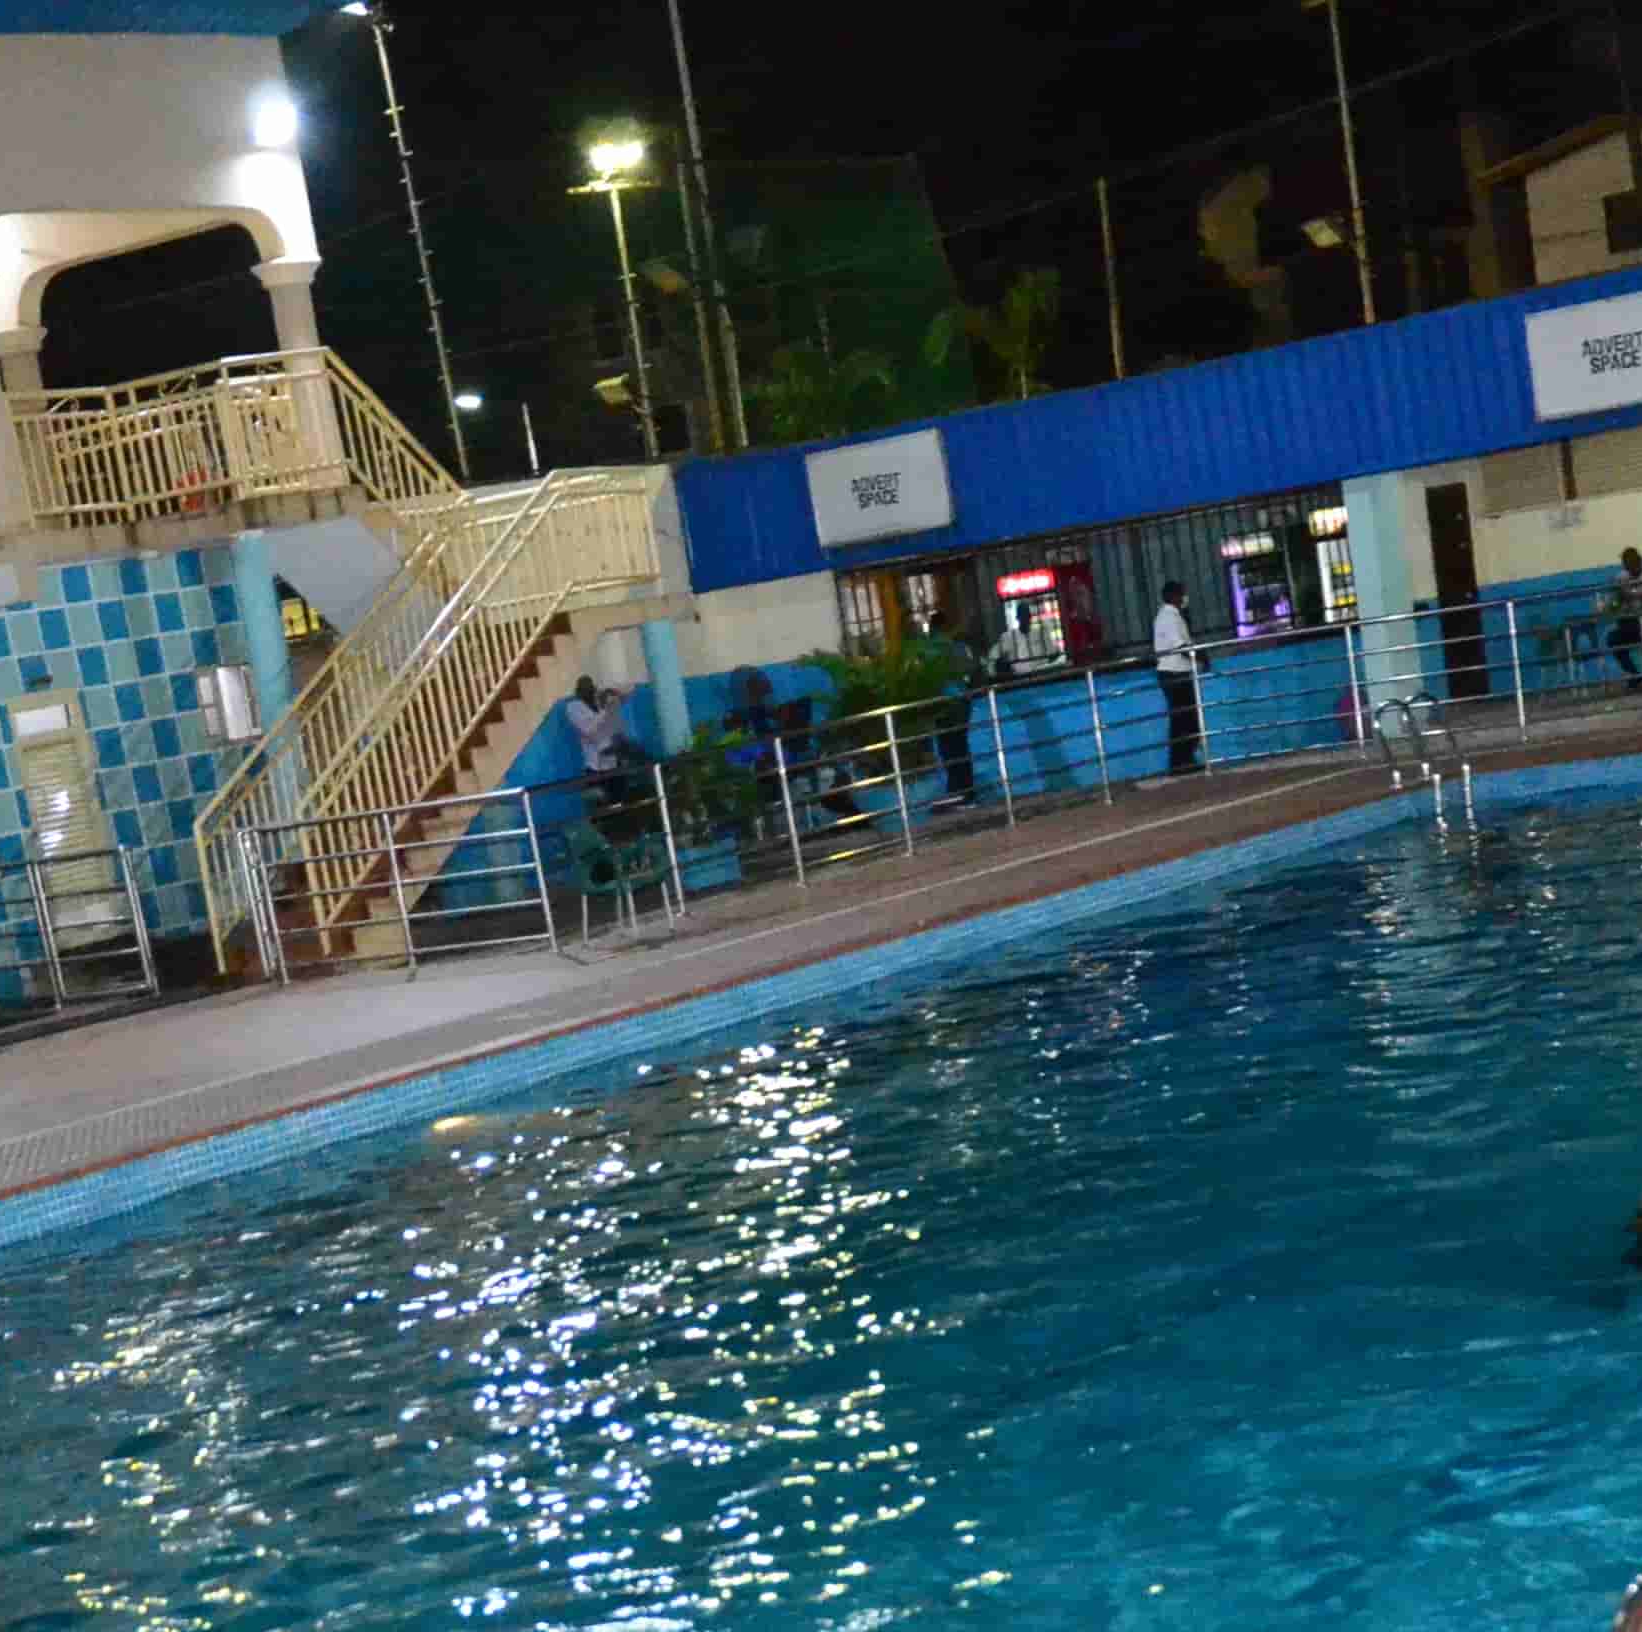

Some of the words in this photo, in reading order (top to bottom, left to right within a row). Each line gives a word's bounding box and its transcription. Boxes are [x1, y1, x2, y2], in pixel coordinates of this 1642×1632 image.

[1589, 349, 1642, 374] SPACE
[851, 471, 902, 493] ADVERT
[859, 488, 901, 510] SPACE
